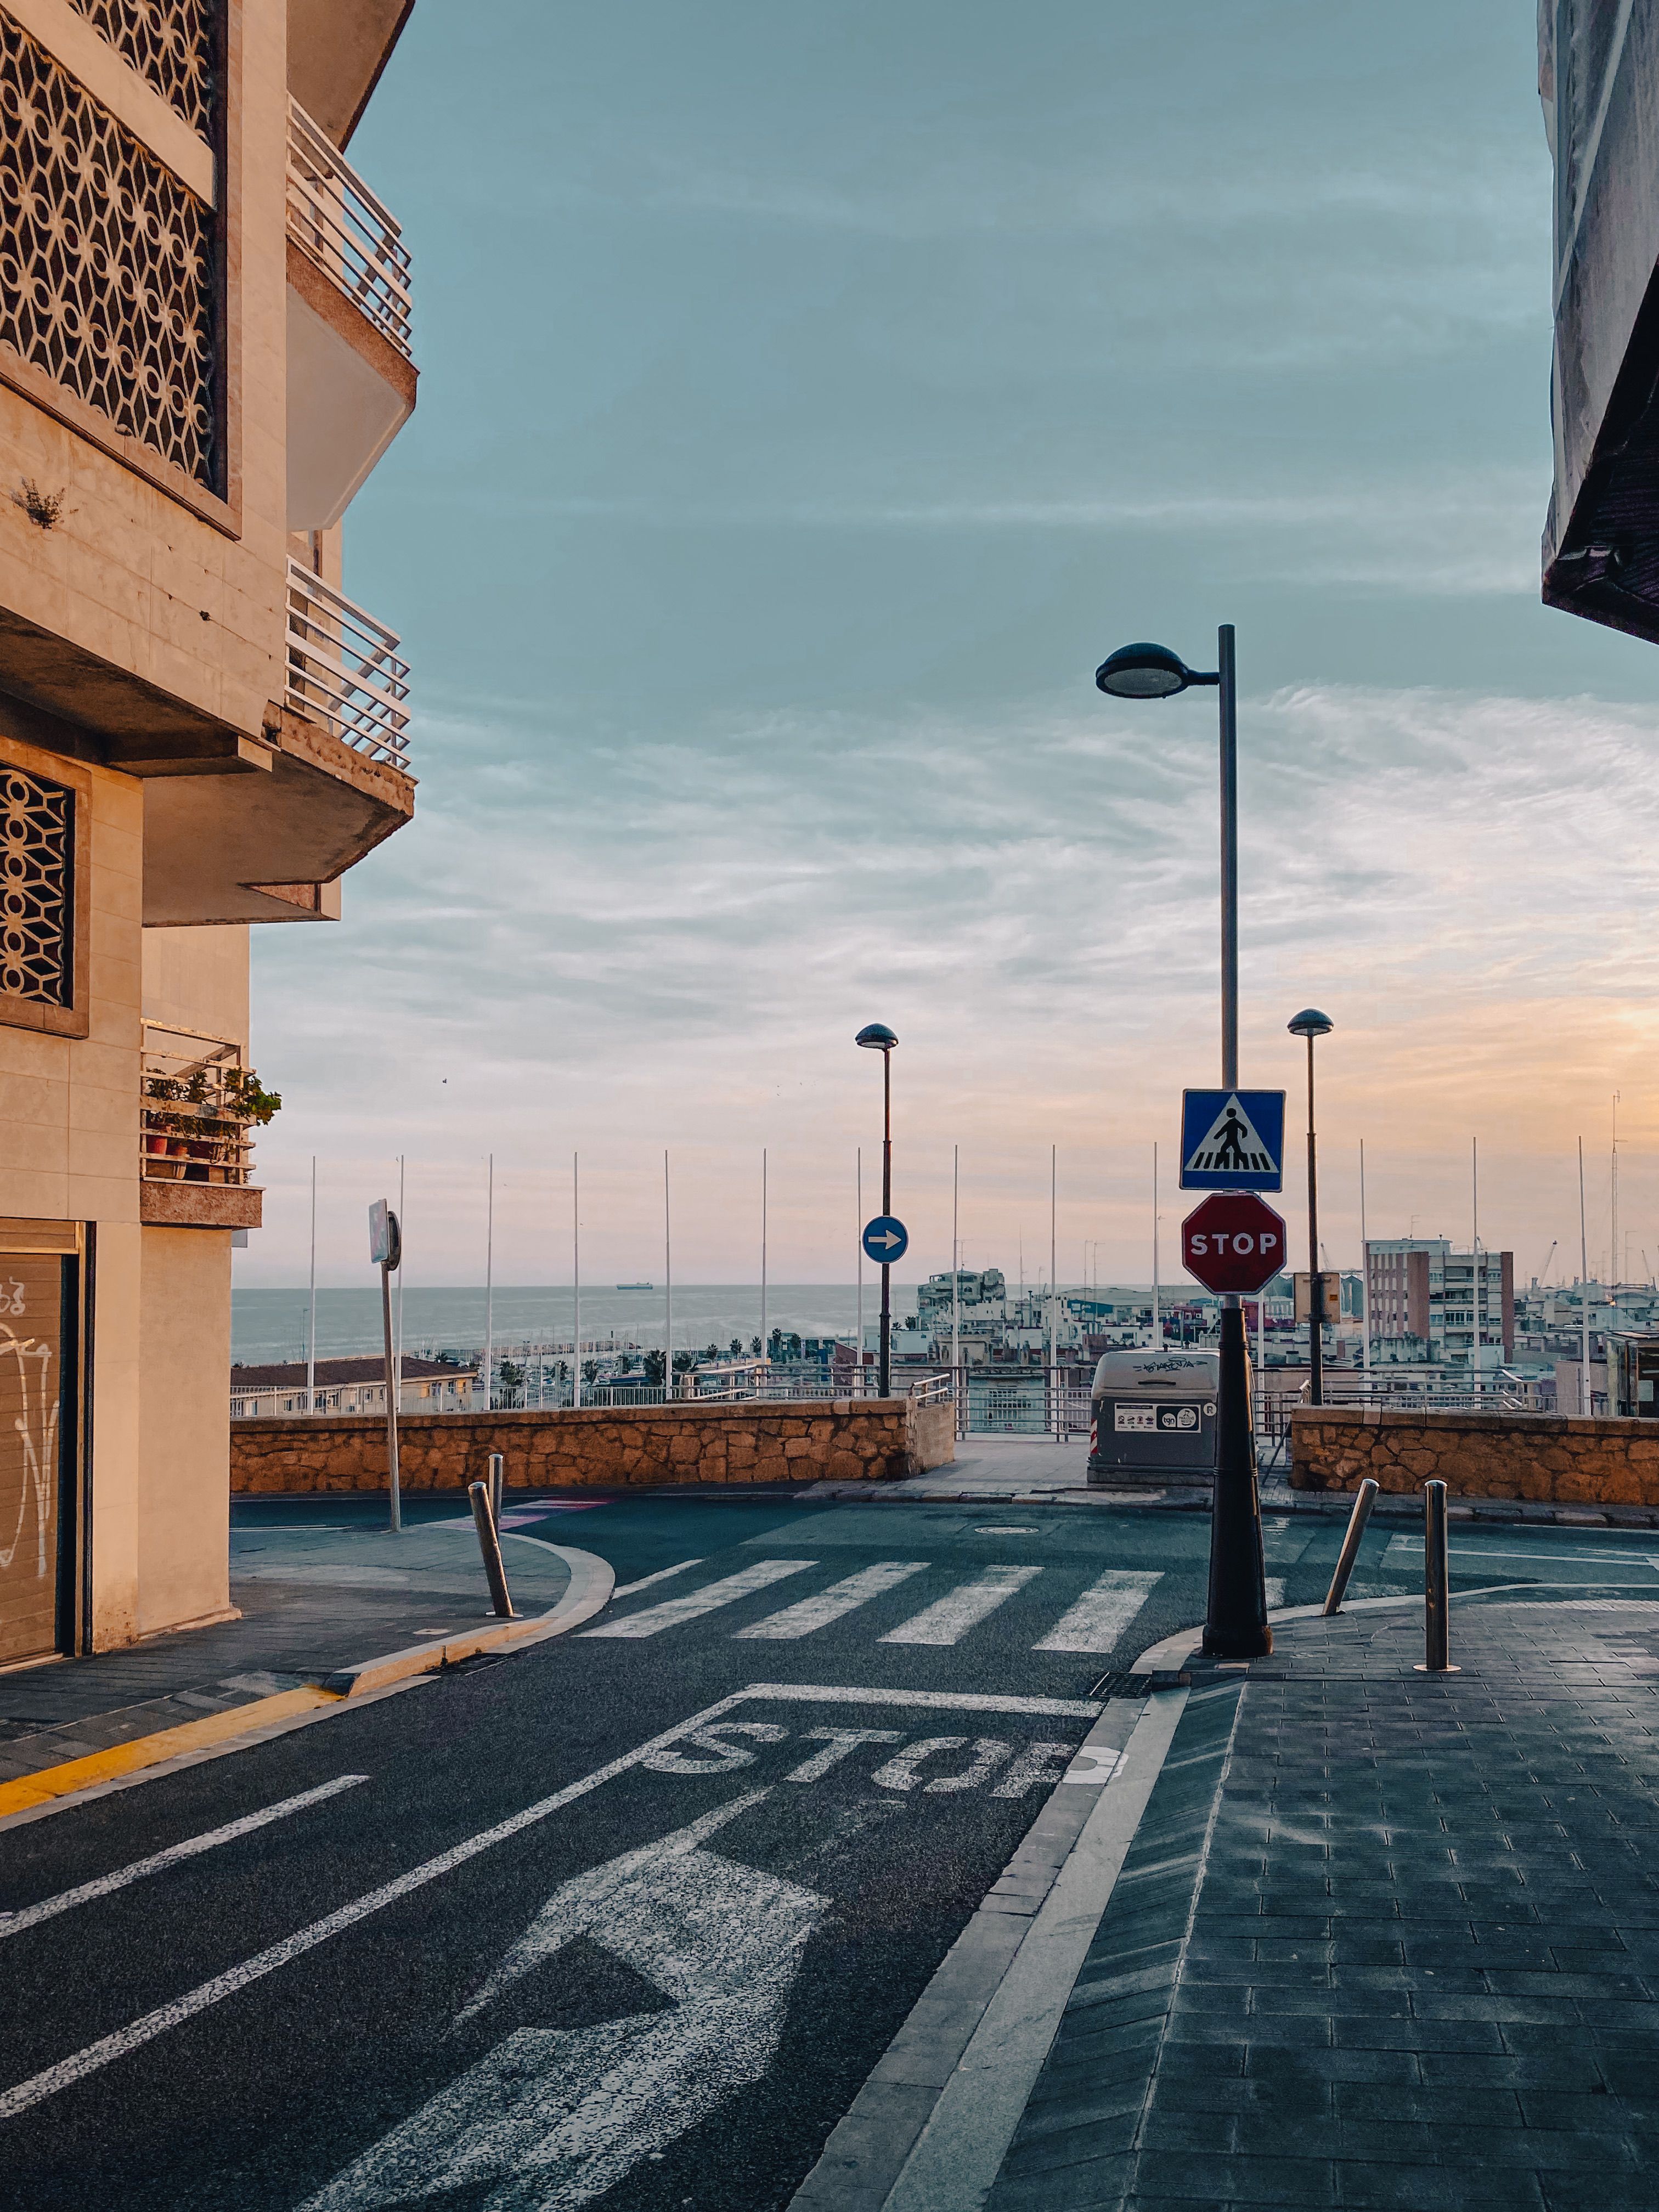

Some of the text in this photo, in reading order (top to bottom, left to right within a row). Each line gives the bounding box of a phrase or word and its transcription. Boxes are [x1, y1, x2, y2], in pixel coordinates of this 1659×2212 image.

[1190, 1233, 1277, 1255] STOP
[1164, 1417, 1175, 1425] tgn
[641, 1722, 1128, 1798] STOP
